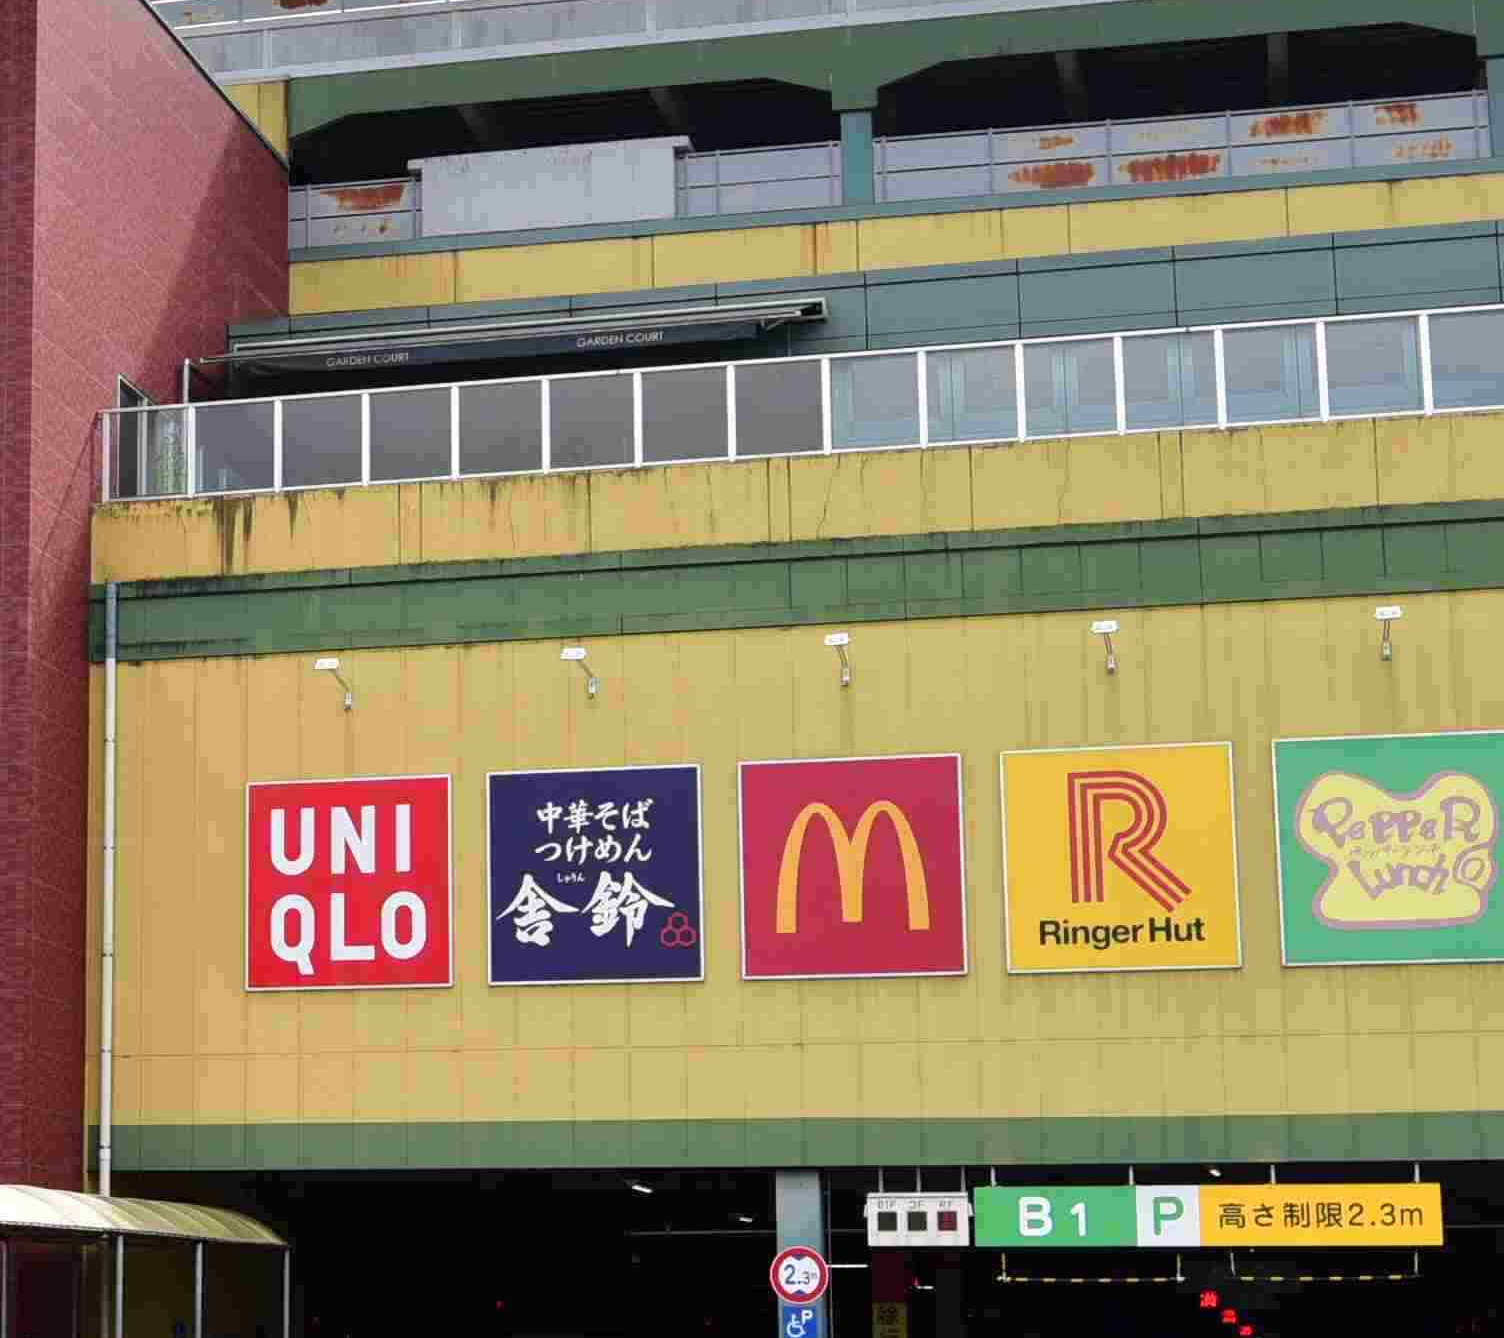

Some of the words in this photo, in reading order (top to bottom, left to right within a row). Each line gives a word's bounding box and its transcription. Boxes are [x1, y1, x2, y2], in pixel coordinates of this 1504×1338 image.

[536, 798, 654, 834] 中華そば
[269, 803, 411, 877] UNI
[535, 833, 652, 865] つけめん
[495, 871, 675, 947] 舎鈴
[269, 891, 427, 975] QLO
[1039, 920, 1144, 950] Ringer
[1148, 918, 1206, 943] Hut
[1153, 1196, 1184, 1236] P
[1218, 1201, 1423, 1229] 高さ制限2.3m
[802, 1310, 813, 1324] P
